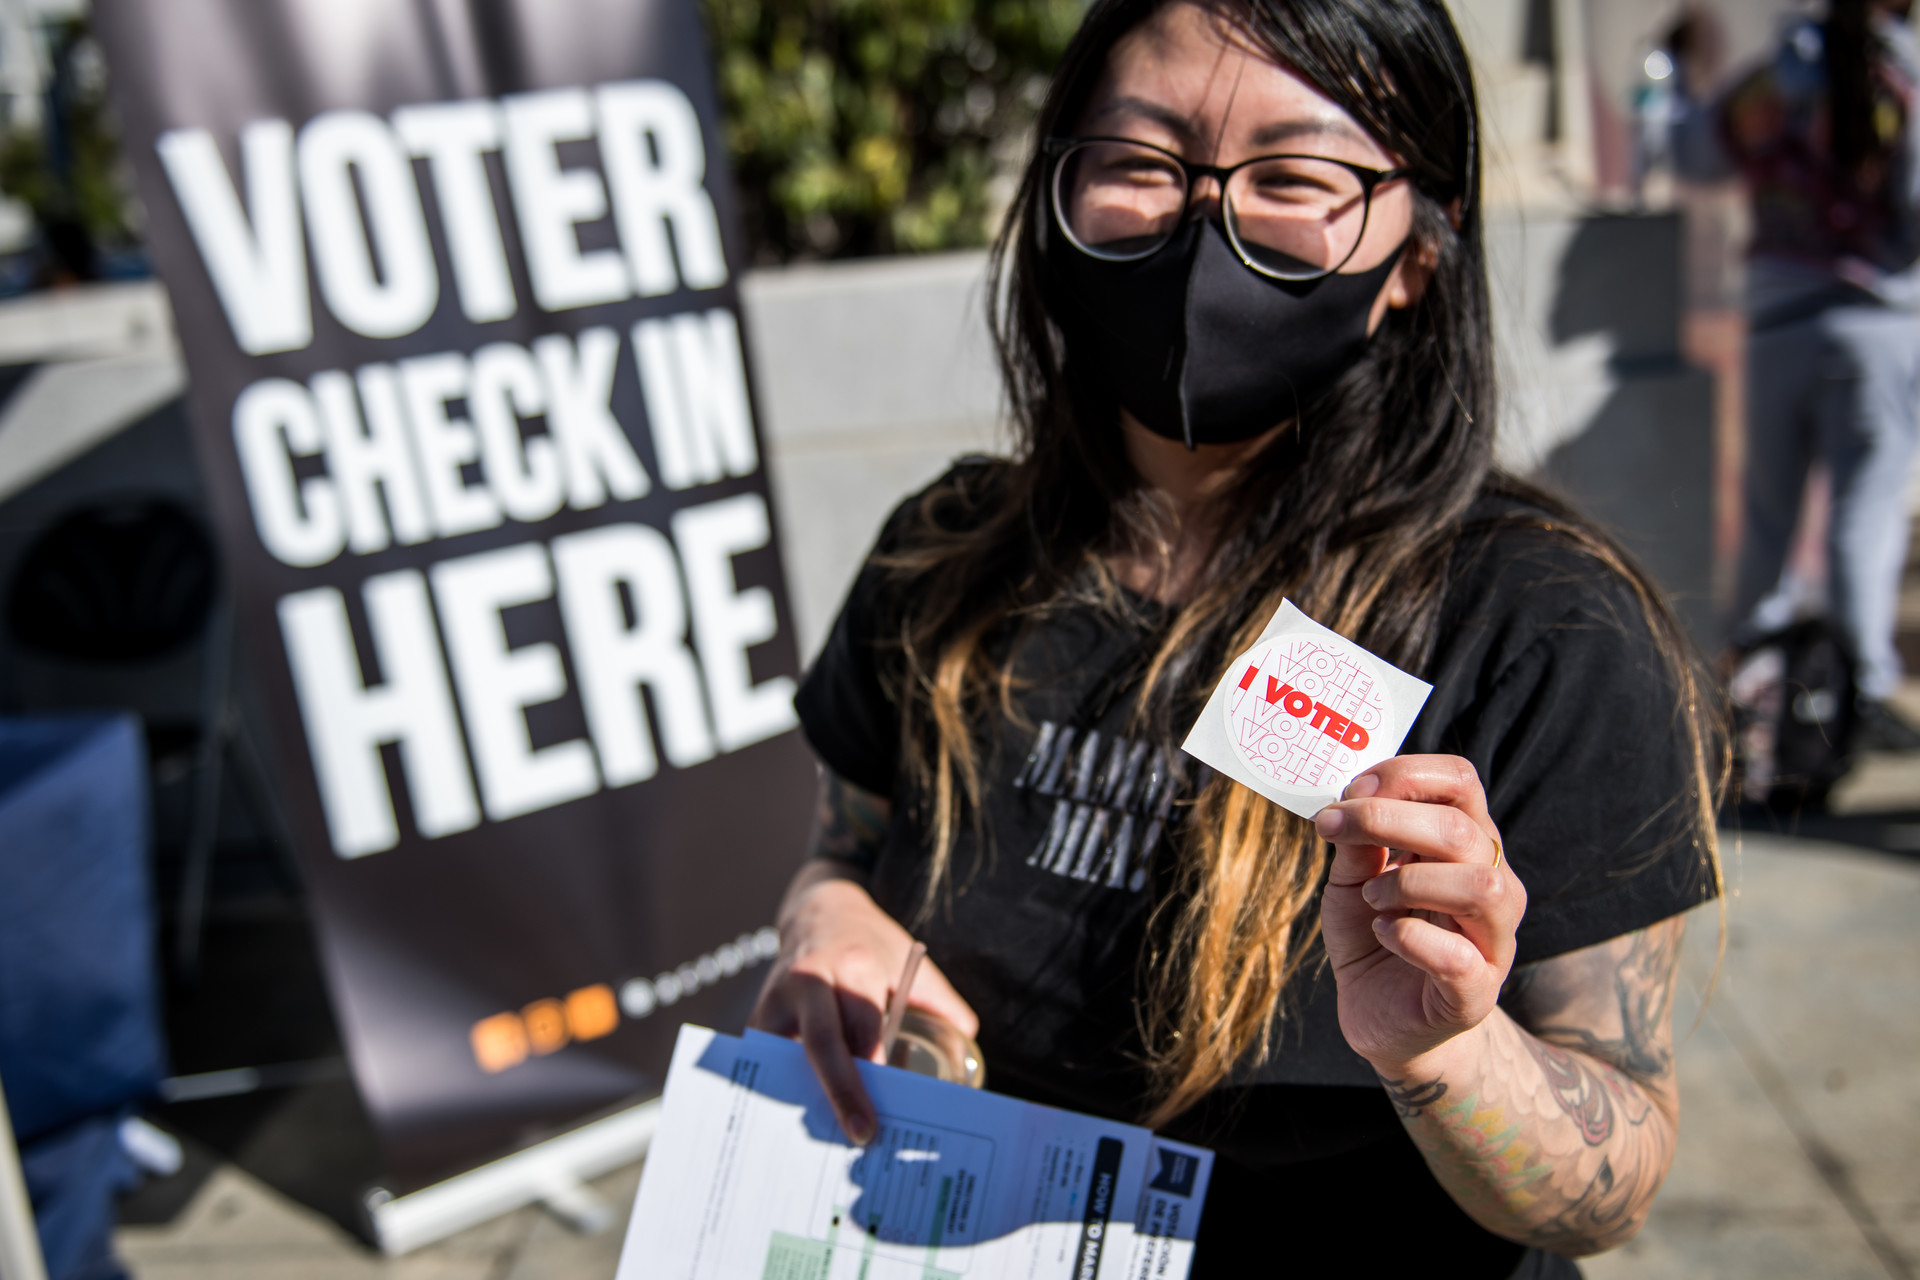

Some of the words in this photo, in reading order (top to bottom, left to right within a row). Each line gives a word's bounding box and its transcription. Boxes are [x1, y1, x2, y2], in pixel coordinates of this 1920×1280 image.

[156, 78, 730, 356] VOTER
[232, 326, 652, 568] CHECK
[630, 309, 757, 490] IN
[276, 492, 801, 860] HERE
[1238, 665, 1259, 691] I
[1266, 675, 1369, 751] VOTED
[1093, 1173, 1112, 1214] HOW
